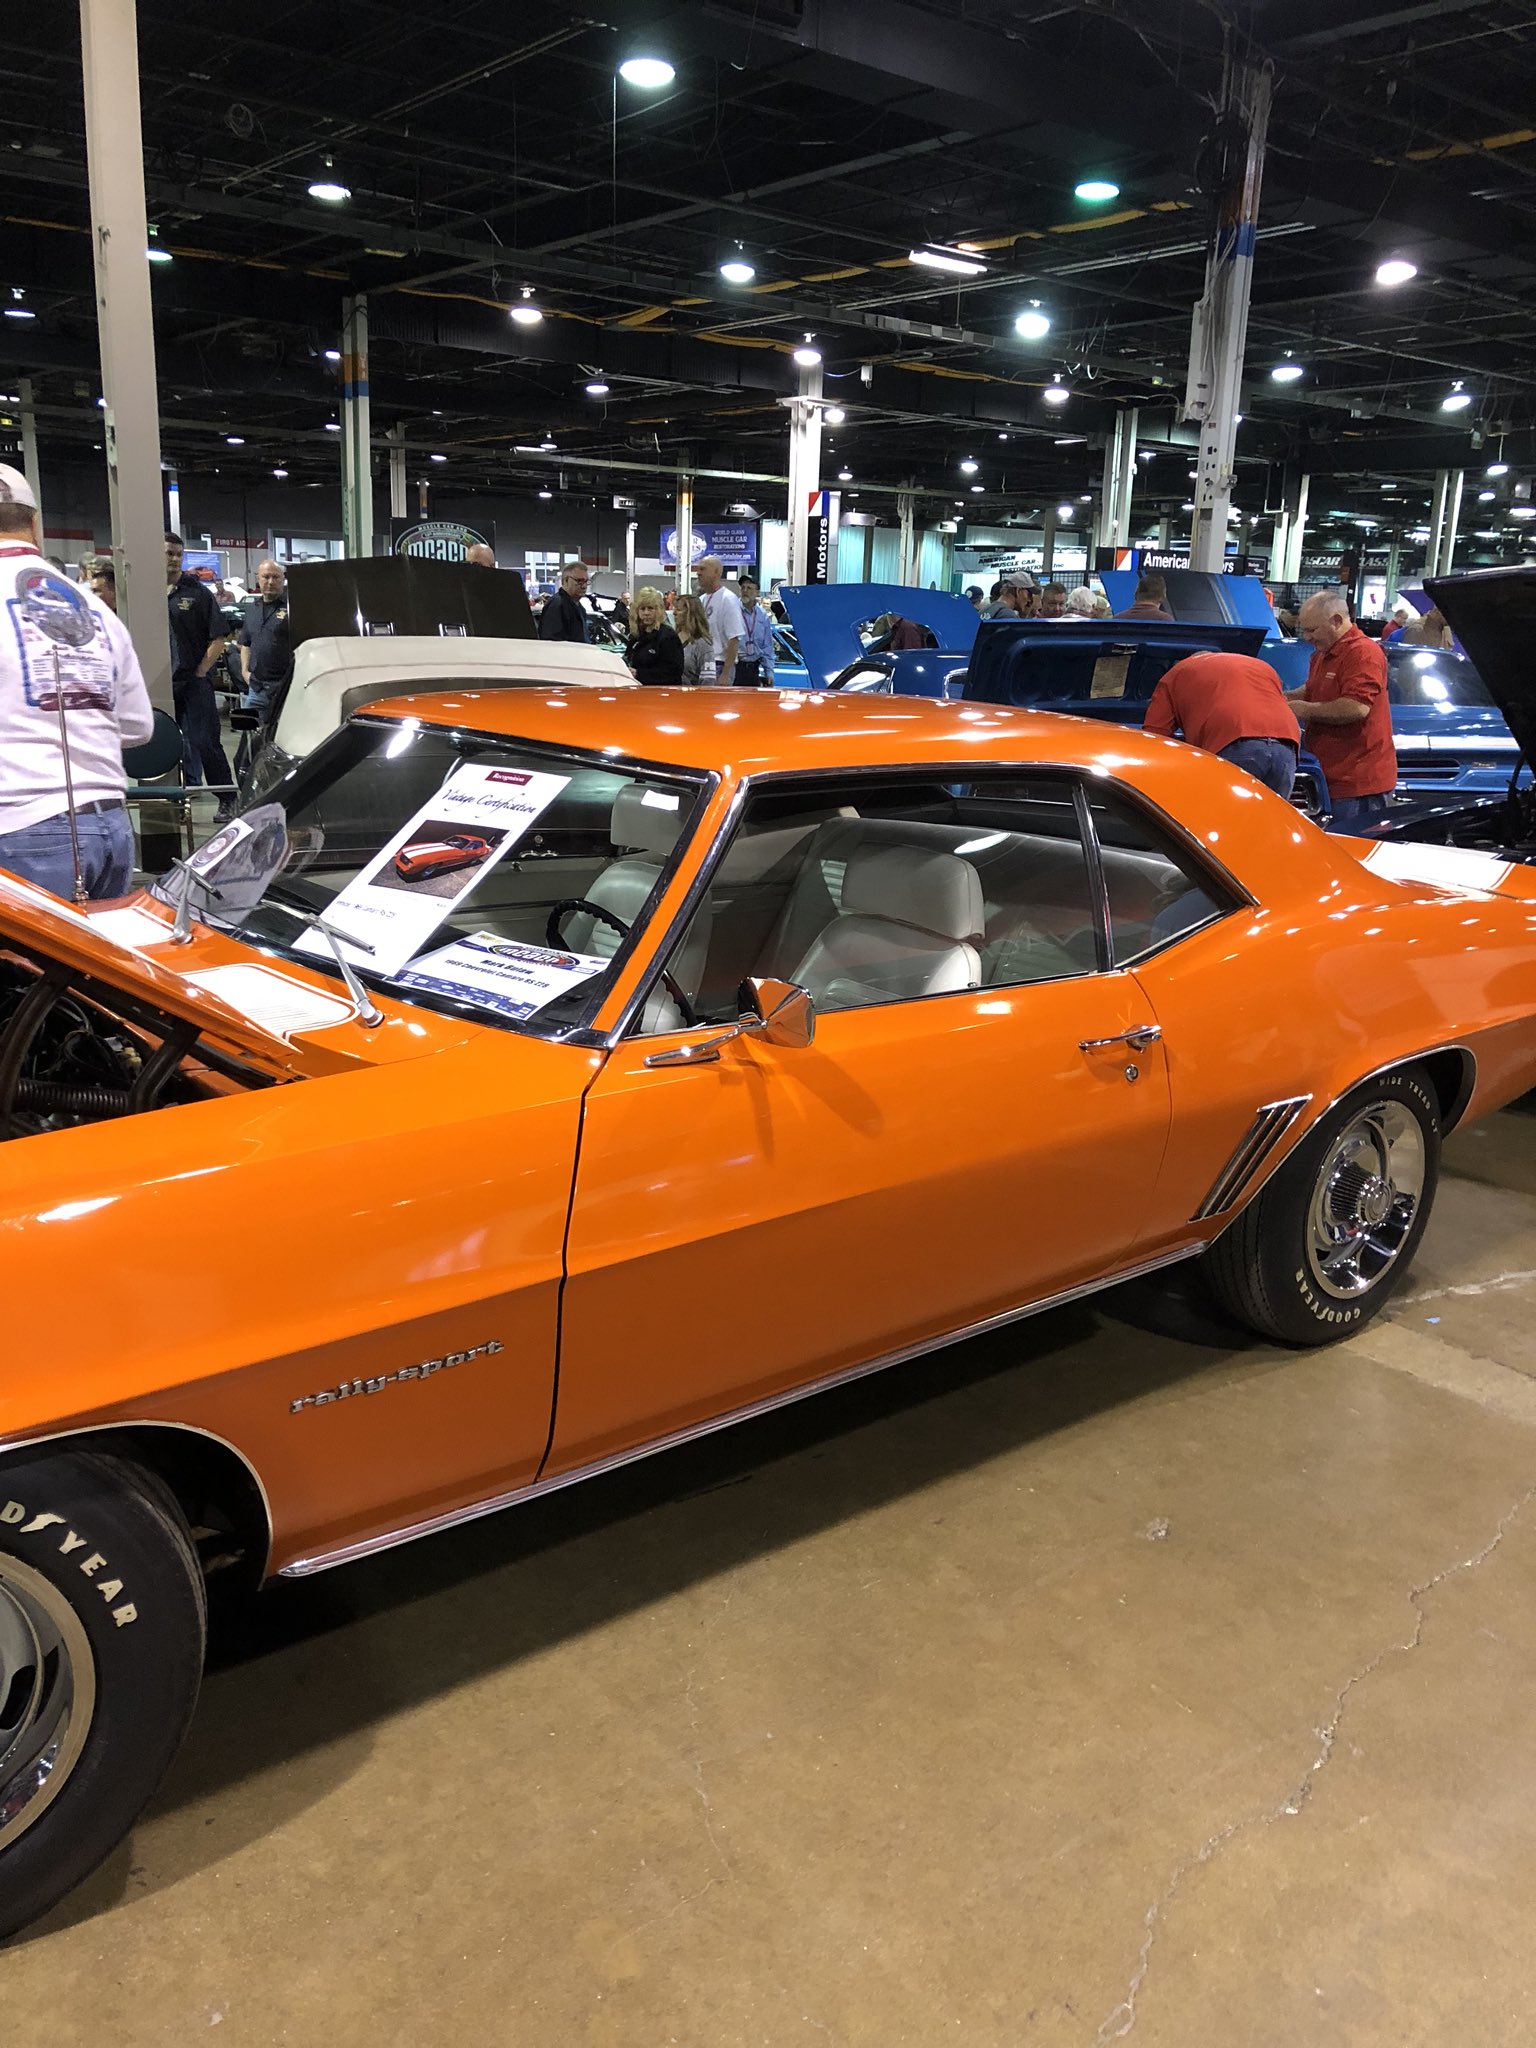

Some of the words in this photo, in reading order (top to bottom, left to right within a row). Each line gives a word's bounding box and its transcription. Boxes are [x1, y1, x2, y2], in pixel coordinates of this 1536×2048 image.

[816, 517, 828, 579] Motors
[978, 555, 1016, 564] AMERICAN
[991, 560, 1019, 568] MUSCLE
[1143, 551, 1190, 569] America
[461, 963, 497, 975] Chevrolet
[496, 971, 524, 981] Camaro
[480, 959, 505, 968] Mark
[1379, 1076, 1402, 1086] WIDE
[1408, 1081, 1431, 1110] TREAD
[1295, 1268, 1361, 1323] GOODYEAR
